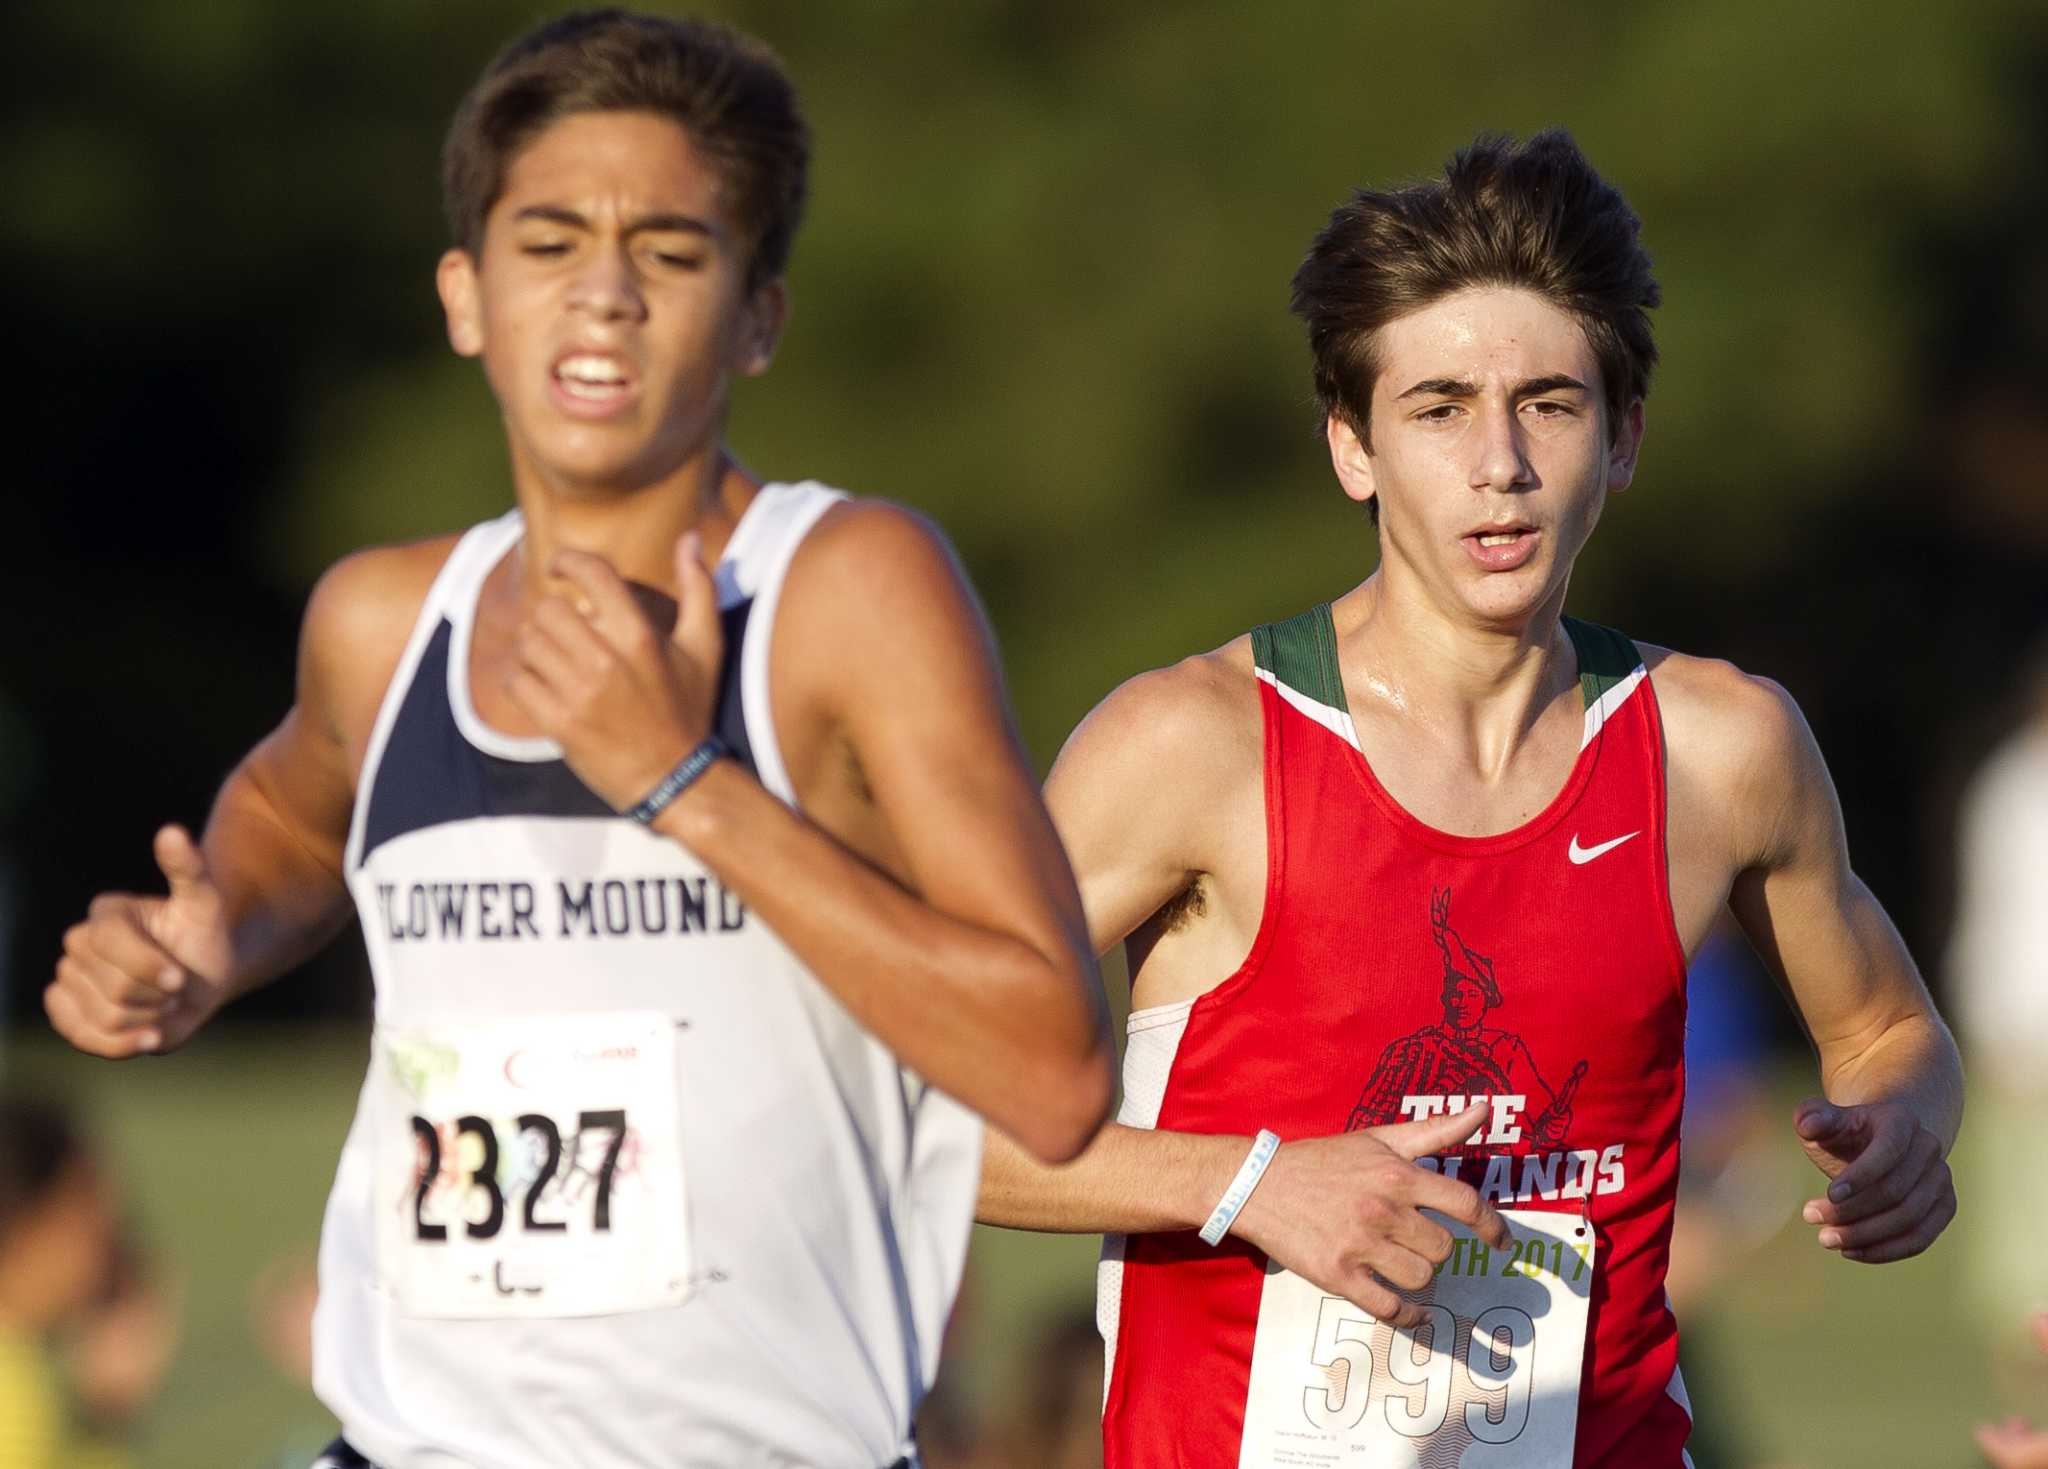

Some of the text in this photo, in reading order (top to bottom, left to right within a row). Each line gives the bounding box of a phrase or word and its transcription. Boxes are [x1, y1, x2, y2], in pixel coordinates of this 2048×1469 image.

[379, 875, 748, 942] LOWER MOUND
[410, 1109, 627, 1242] 2327
[1434, 1237, 1591, 1282] TH 2017
[1301, 1296, 1536, 1446] 599
